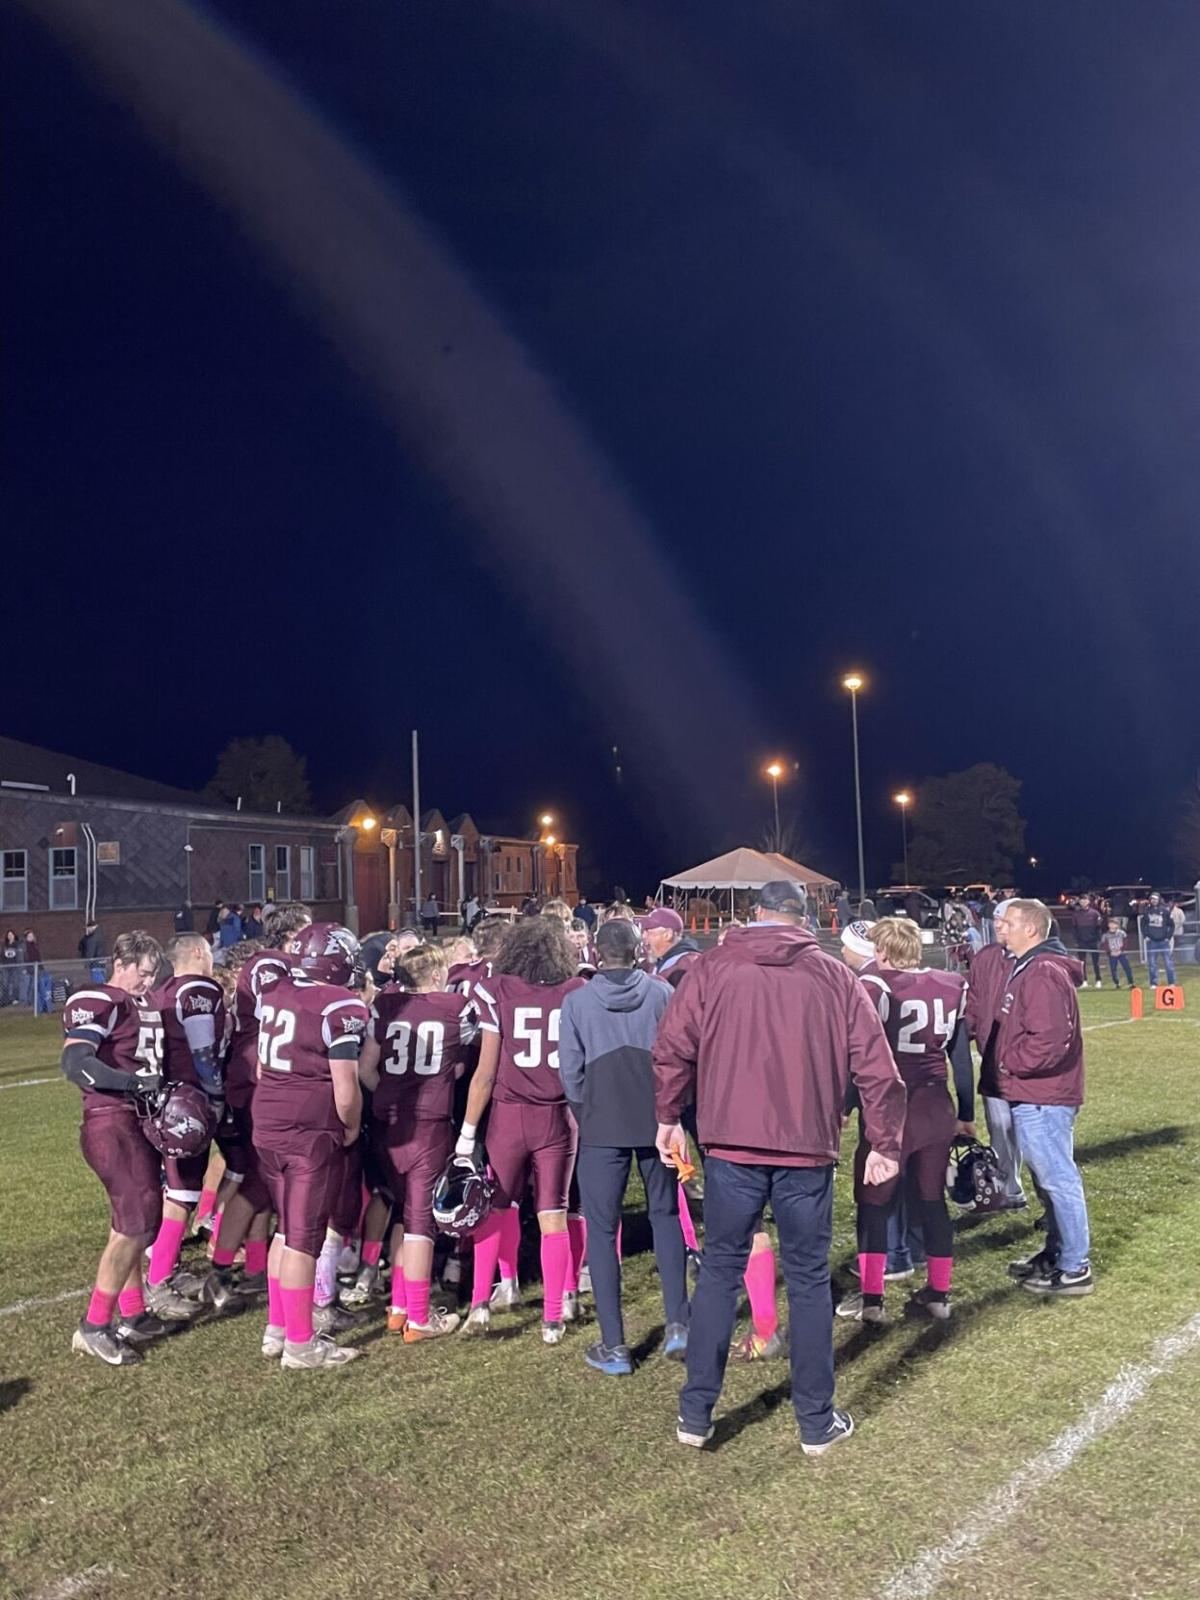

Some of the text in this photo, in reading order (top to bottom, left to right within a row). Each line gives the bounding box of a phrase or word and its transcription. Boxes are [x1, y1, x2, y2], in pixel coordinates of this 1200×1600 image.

[1162, 988, 1175, 1007] G
[258, 1005, 296, 1072] 62
[385, 1021, 445, 1076] 30
[898, 998, 957, 1053] 24
